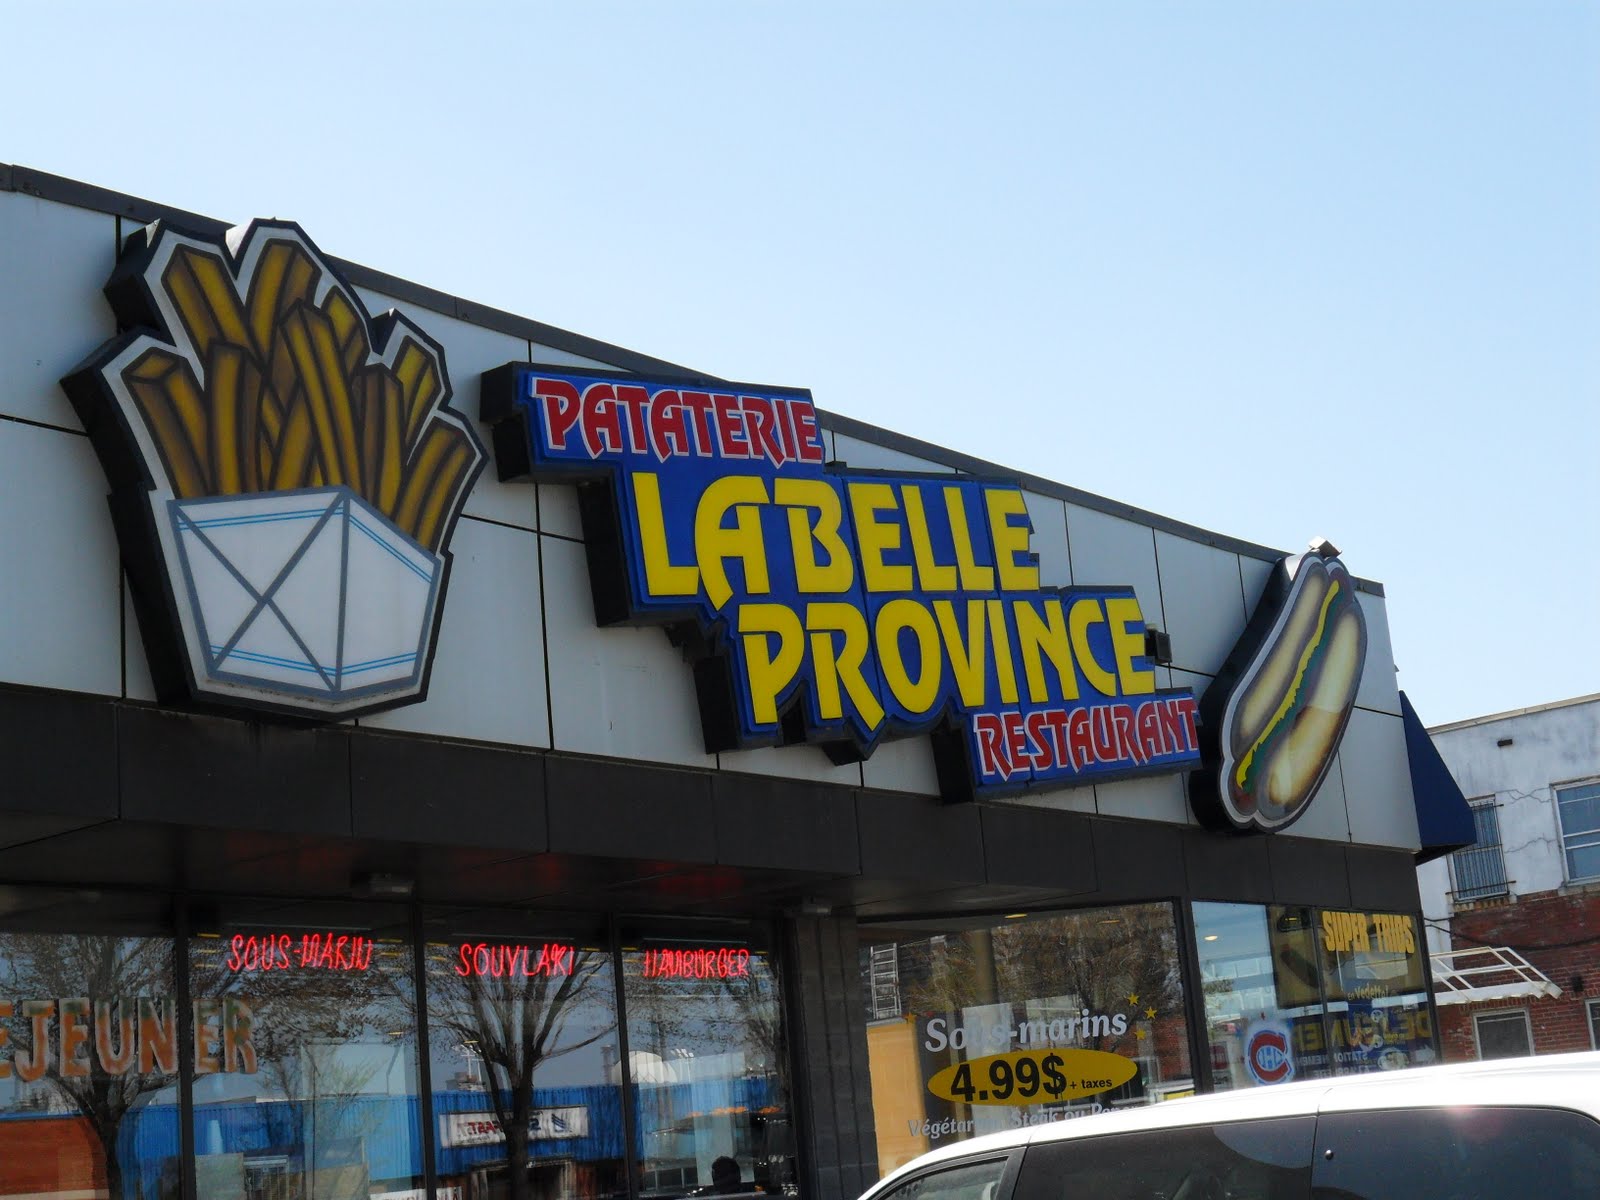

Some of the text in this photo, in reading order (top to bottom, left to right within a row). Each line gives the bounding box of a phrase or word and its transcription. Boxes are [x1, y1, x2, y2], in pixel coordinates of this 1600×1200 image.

[532, 377, 823, 469] PATATERIE
[738, 598, 1155, 731] PROVINCE
[973, 696, 1199, 781] RESTAURANT
[1322, 911, 1370, 952] SUPER
[455, 942, 575, 977] SOUVLAKI
[643, 948, 750, 979] HAMBURGER
[925, 1008, 1127, 1052] Sous-marins
[951, 1052, 1067, 1102] 4.99$
[1081, 1078, 1113, 1090] taxes
